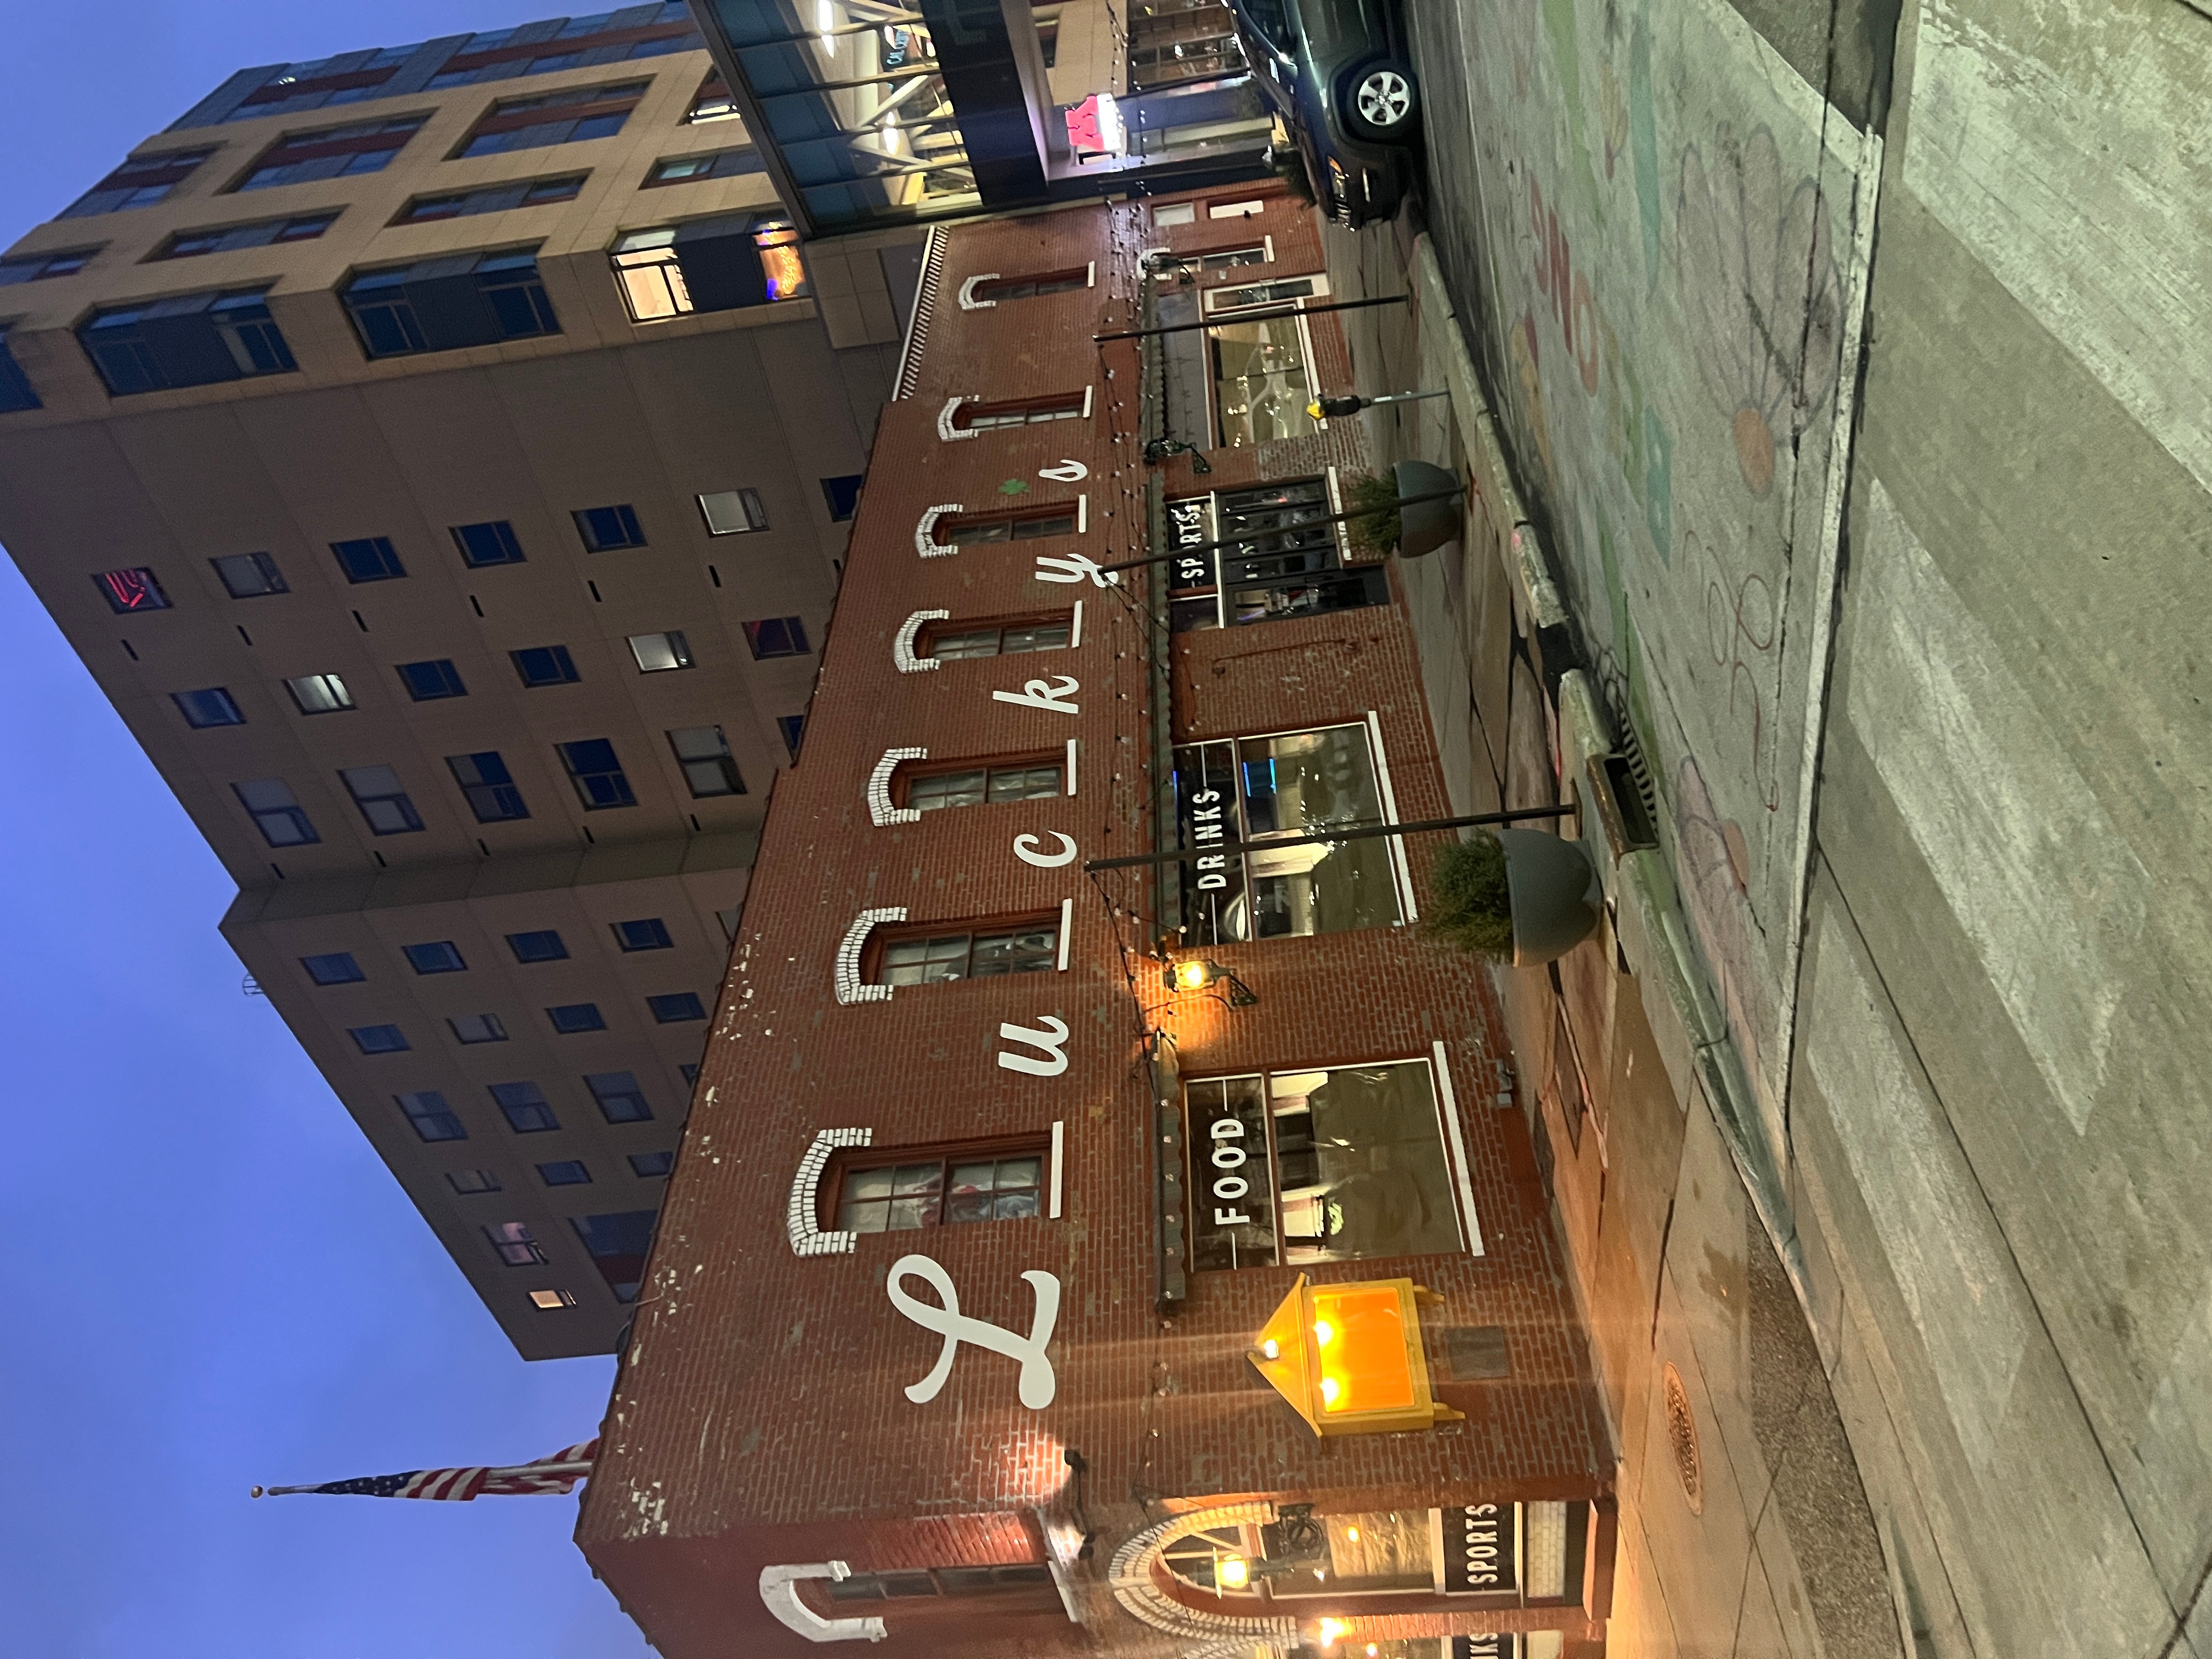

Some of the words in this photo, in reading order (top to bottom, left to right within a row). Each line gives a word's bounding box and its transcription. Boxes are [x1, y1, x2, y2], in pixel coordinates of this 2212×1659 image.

[1178, 512, 1205, 579] SPRTS
[1210, 1118, 1250, 1226] FOOD
[1464, 1503, 1498, 1584] SPORTS
